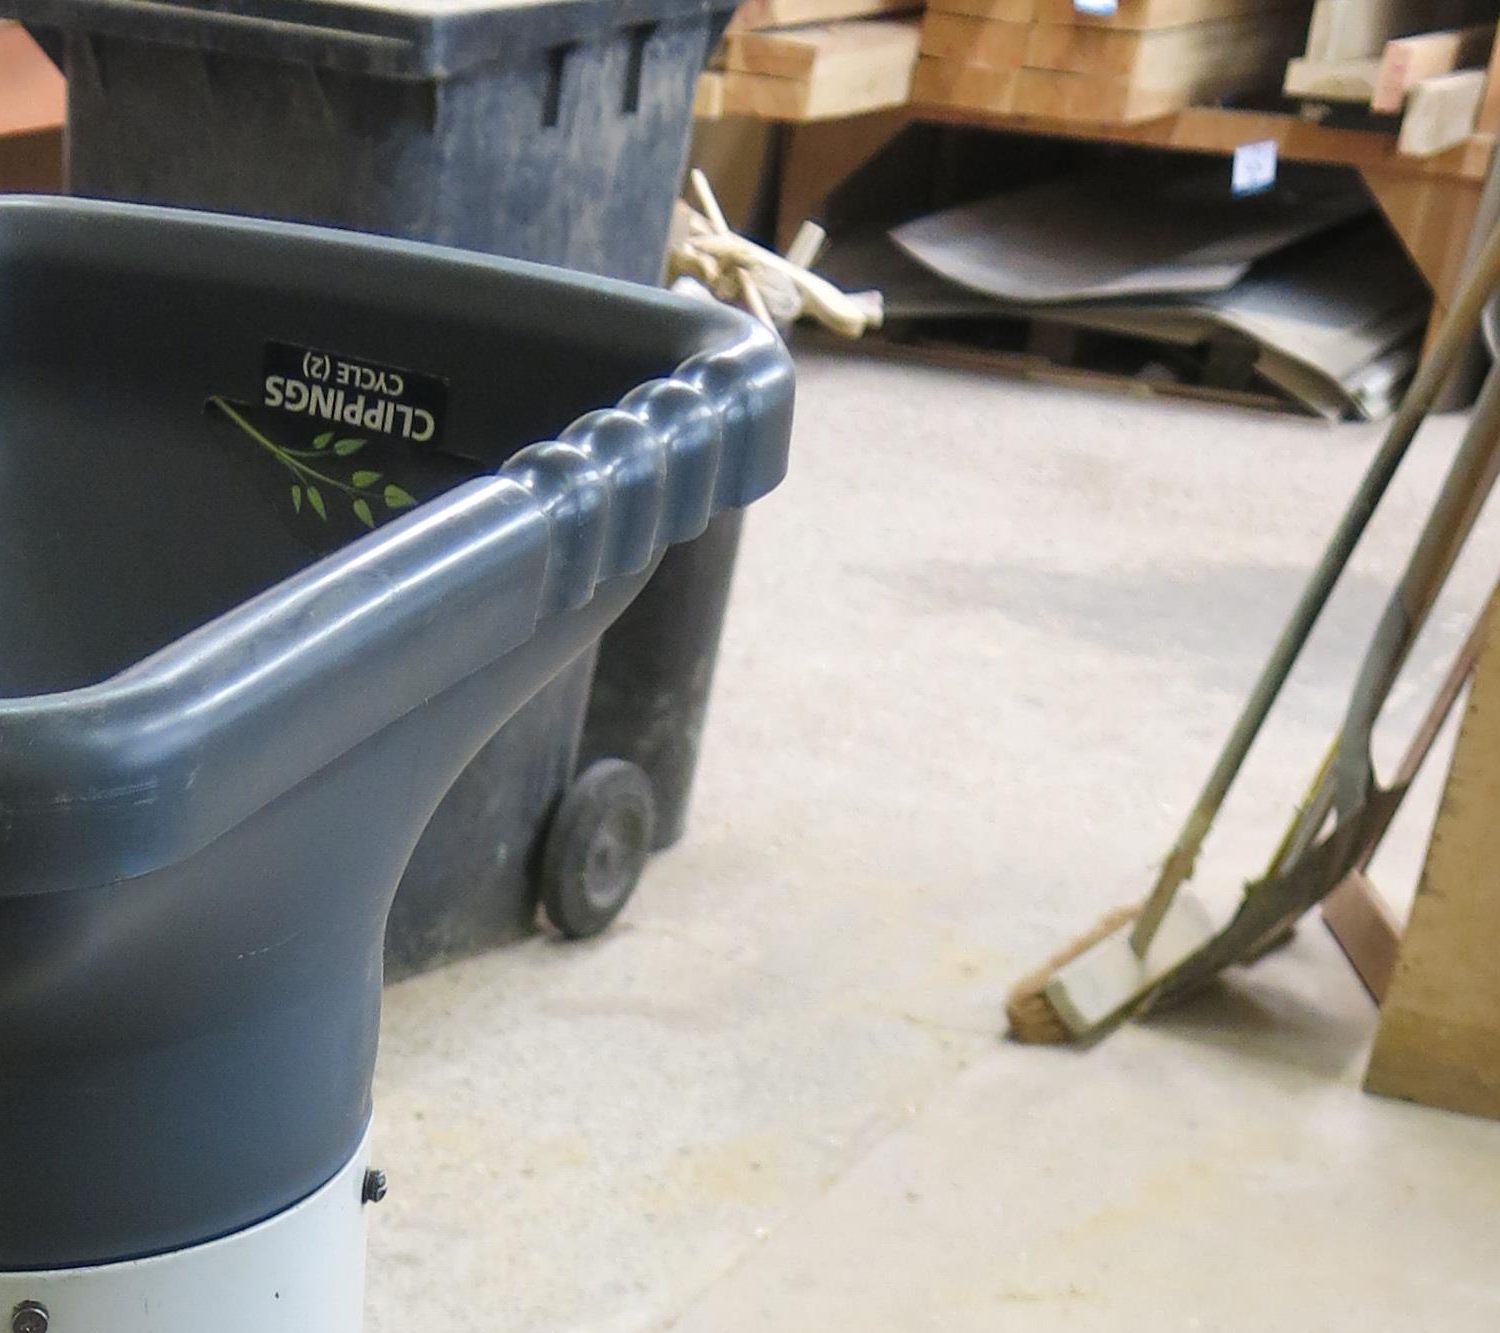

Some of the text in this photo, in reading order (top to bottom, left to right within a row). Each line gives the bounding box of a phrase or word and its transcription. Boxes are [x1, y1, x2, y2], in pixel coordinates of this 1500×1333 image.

[303, 351, 404, 396] CYCLE (2)
[264, 375, 435, 442] CLIPPINGS
